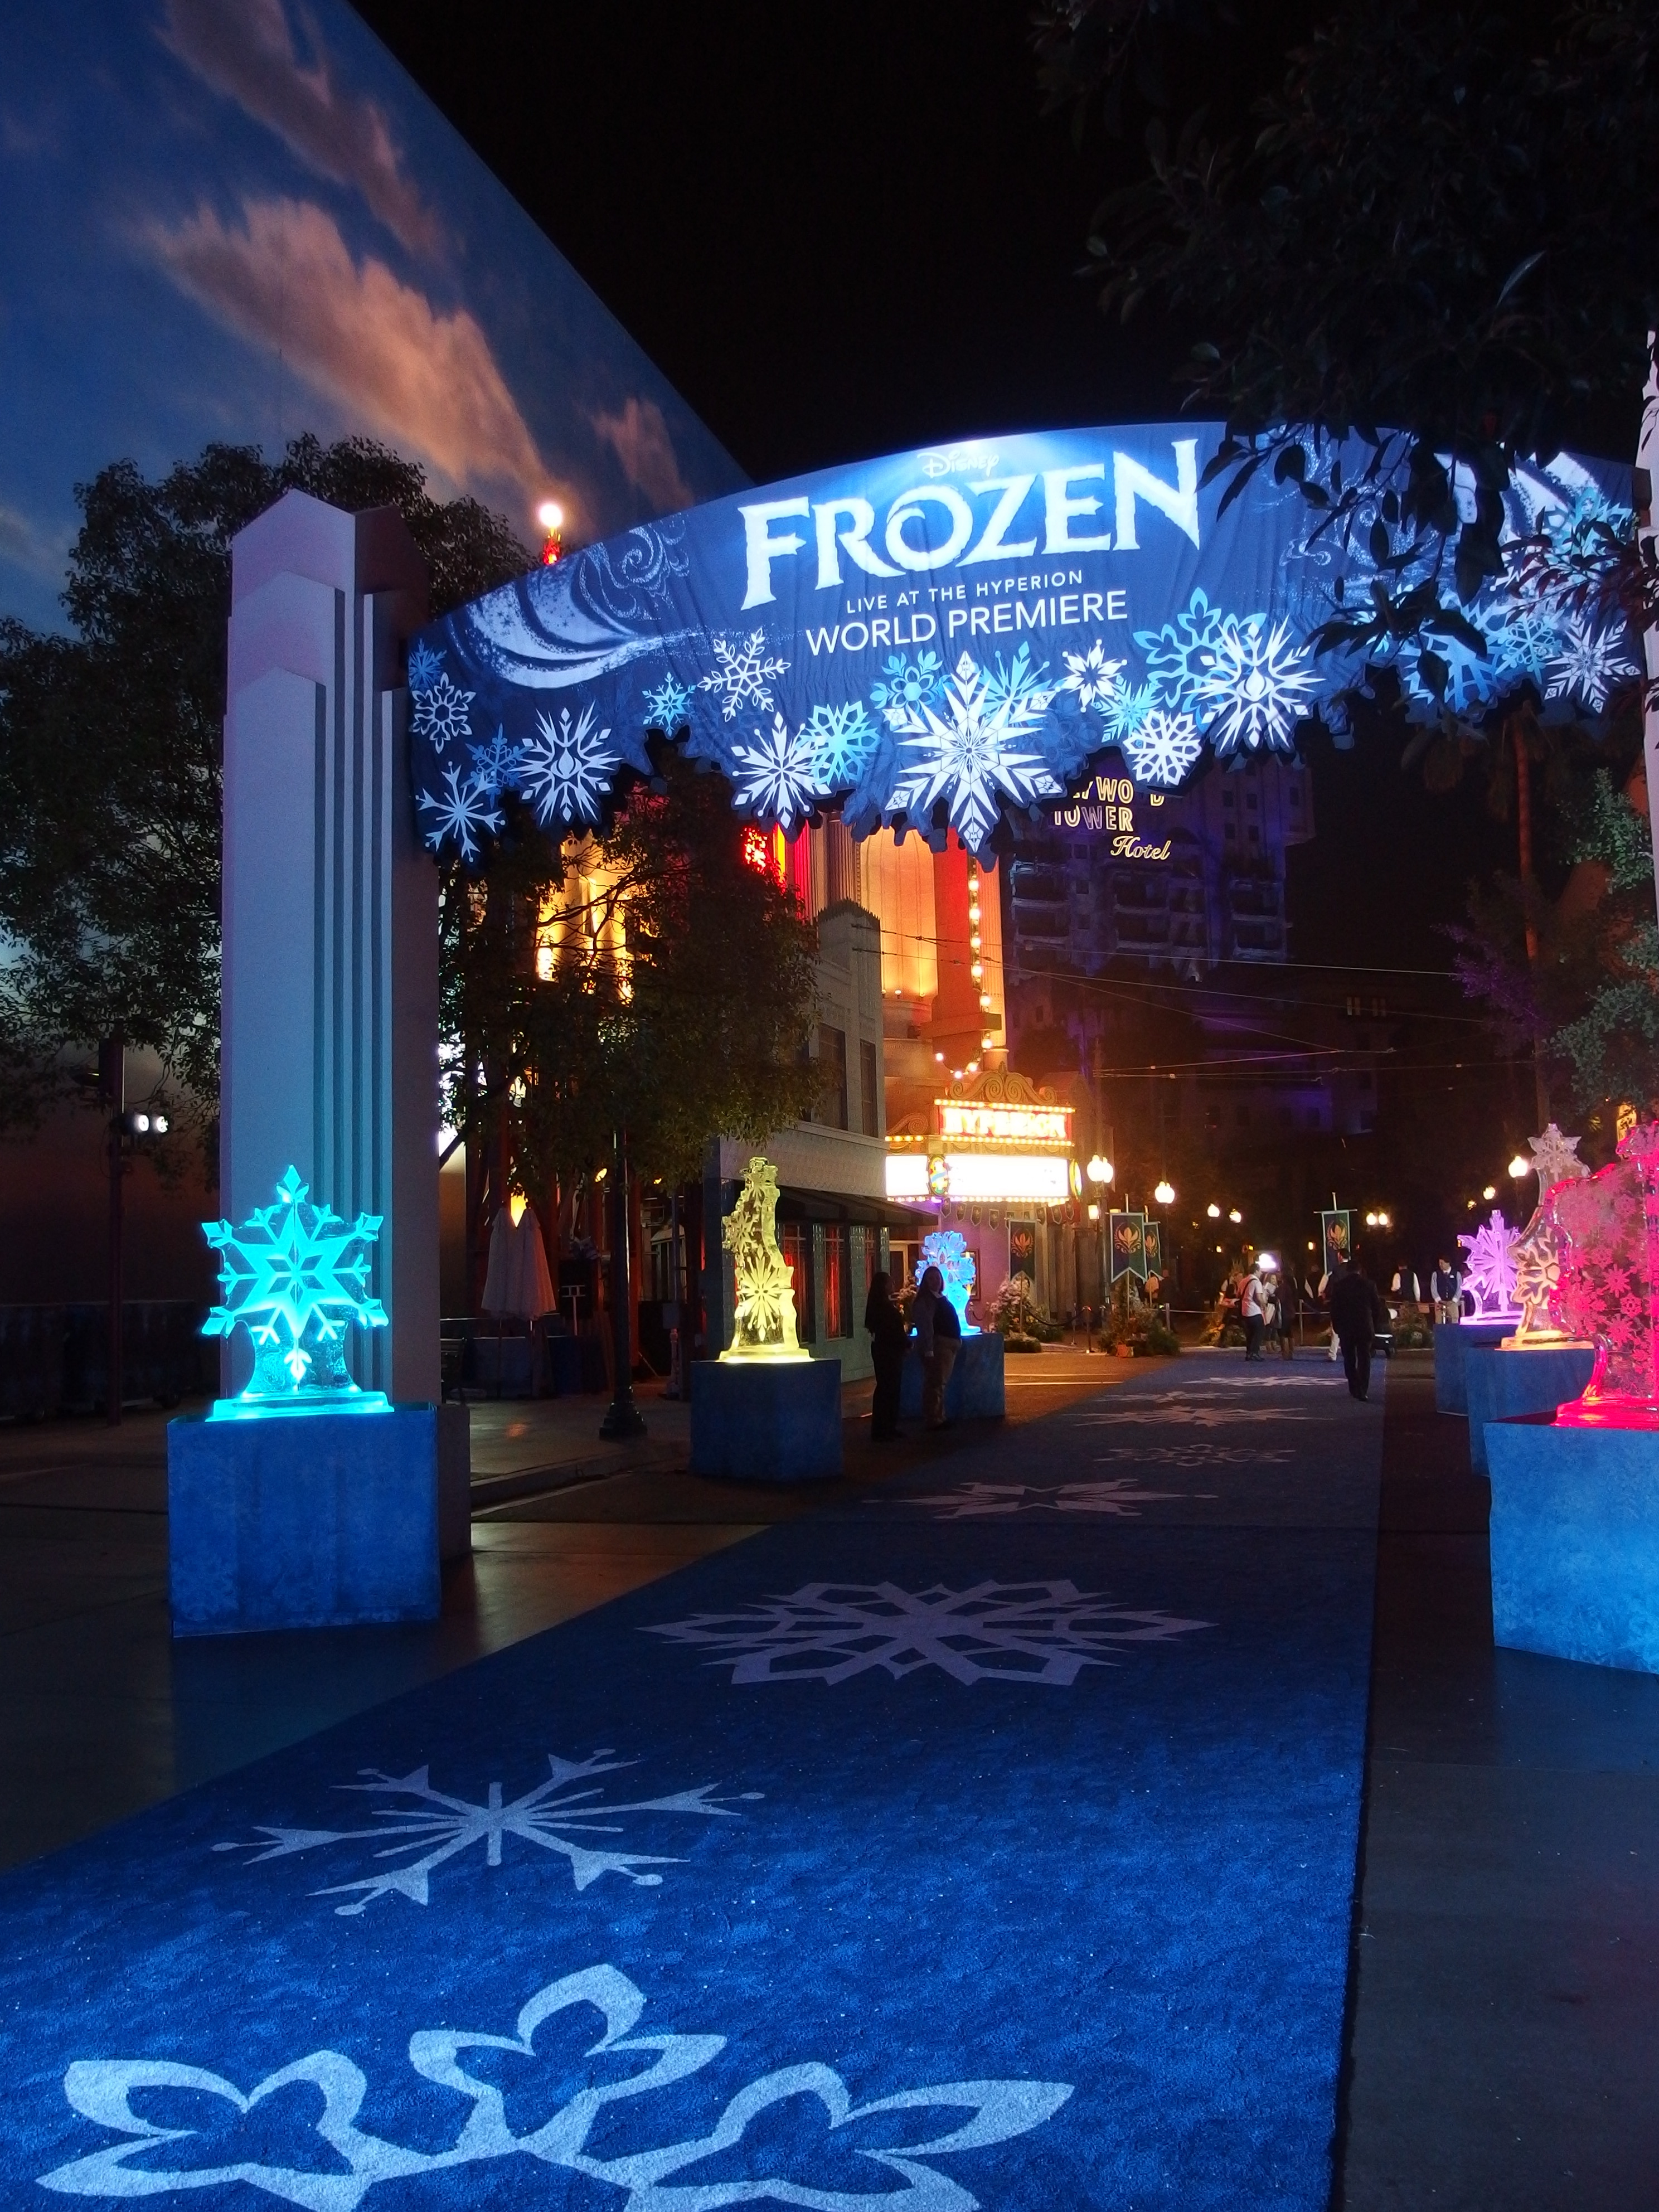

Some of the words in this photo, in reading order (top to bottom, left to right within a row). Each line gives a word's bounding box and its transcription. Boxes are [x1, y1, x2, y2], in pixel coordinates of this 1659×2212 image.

[737, 438, 1200, 611] FROZEN
[846, 594, 888, 614] LIVE
[896, 590, 920, 608] AT
[928, 584, 967, 603] THE
[976, 569, 1083, 598] HYPERION
[806, 613, 937, 656] WORLD
[948, 589, 1129, 638] PREMIERE
[1110, 836, 1172, 861] Hotel
